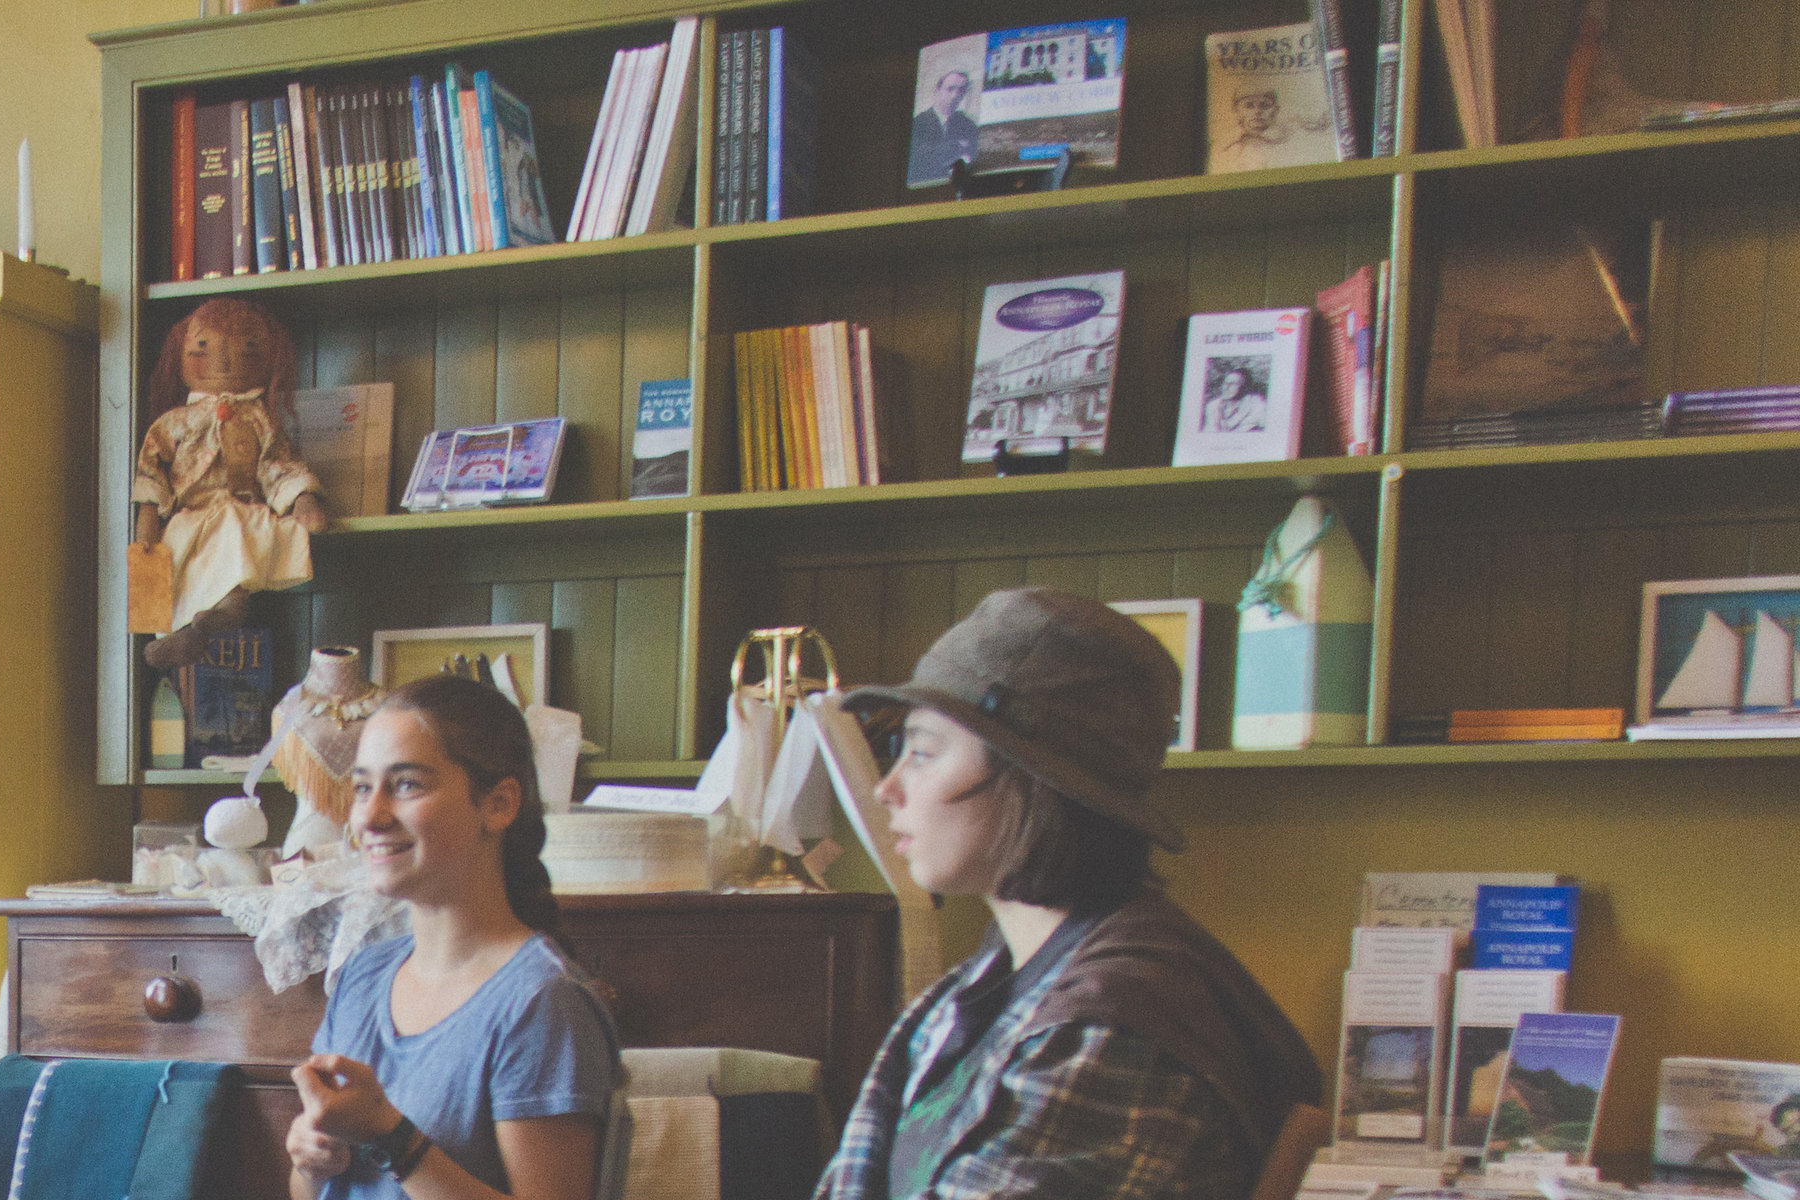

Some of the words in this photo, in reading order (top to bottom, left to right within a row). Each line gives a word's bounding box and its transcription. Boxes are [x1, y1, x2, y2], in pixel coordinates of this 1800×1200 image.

[1218, 37, 1292, 55] YEARS
[1299, 34, 1316, 49] O
[1203, 333, 1234, 345] LAST
[1237, 331, 1275, 343] WORDS
[640, 407, 692, 423] ROY
[1486, 898, 1563, 910] ANNAPOLIS
[1502, 909, 1545, 921] ROYAL
[1486, 943, 1562, 955] ANNAPOLIS
[1501, 954, 1544, 966] ROYAL
